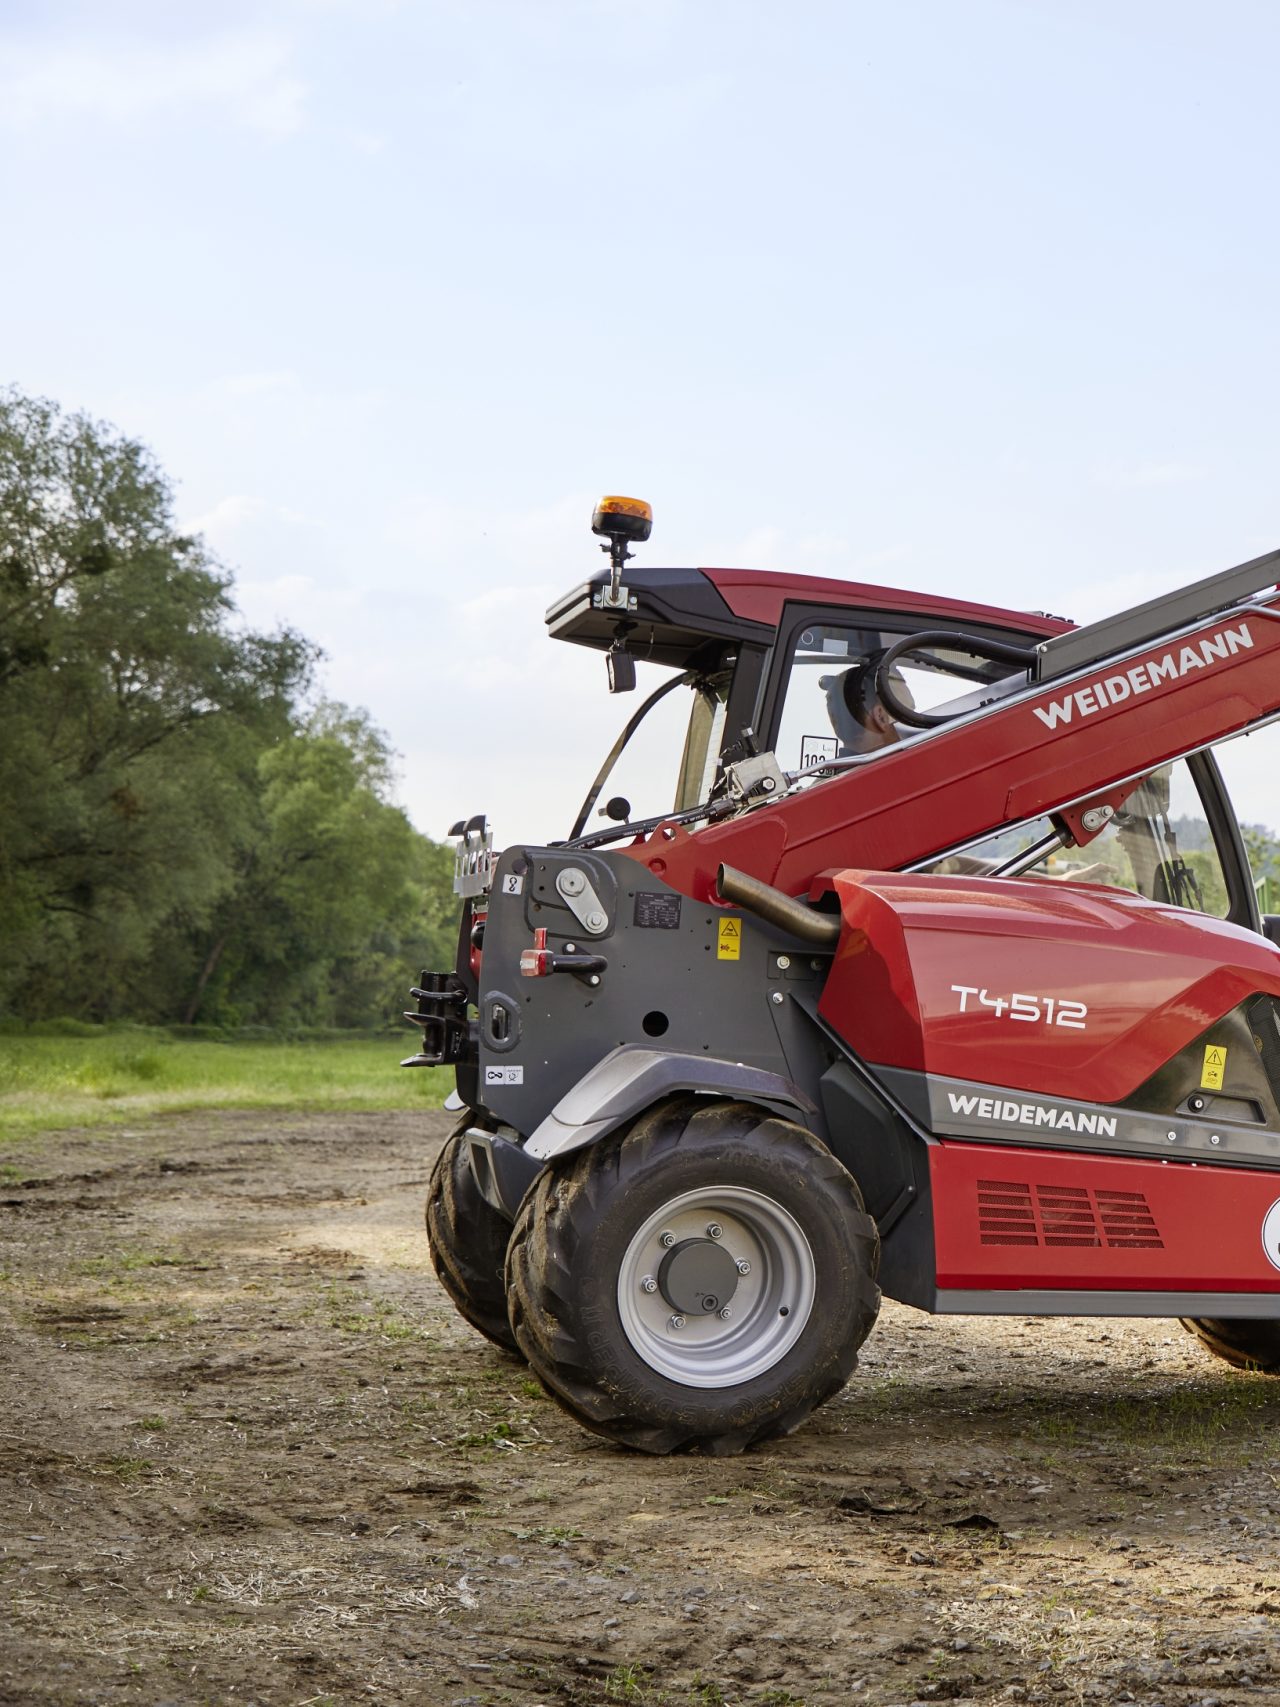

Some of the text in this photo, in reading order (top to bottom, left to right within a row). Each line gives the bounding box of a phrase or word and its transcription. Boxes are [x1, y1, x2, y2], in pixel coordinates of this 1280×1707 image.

[1033, 623, 1254, 730] WEIDEMANN
[951, 984, 1088, 1029] T4512
[947, 1092, 1118, 1137] WEIDEMANN
